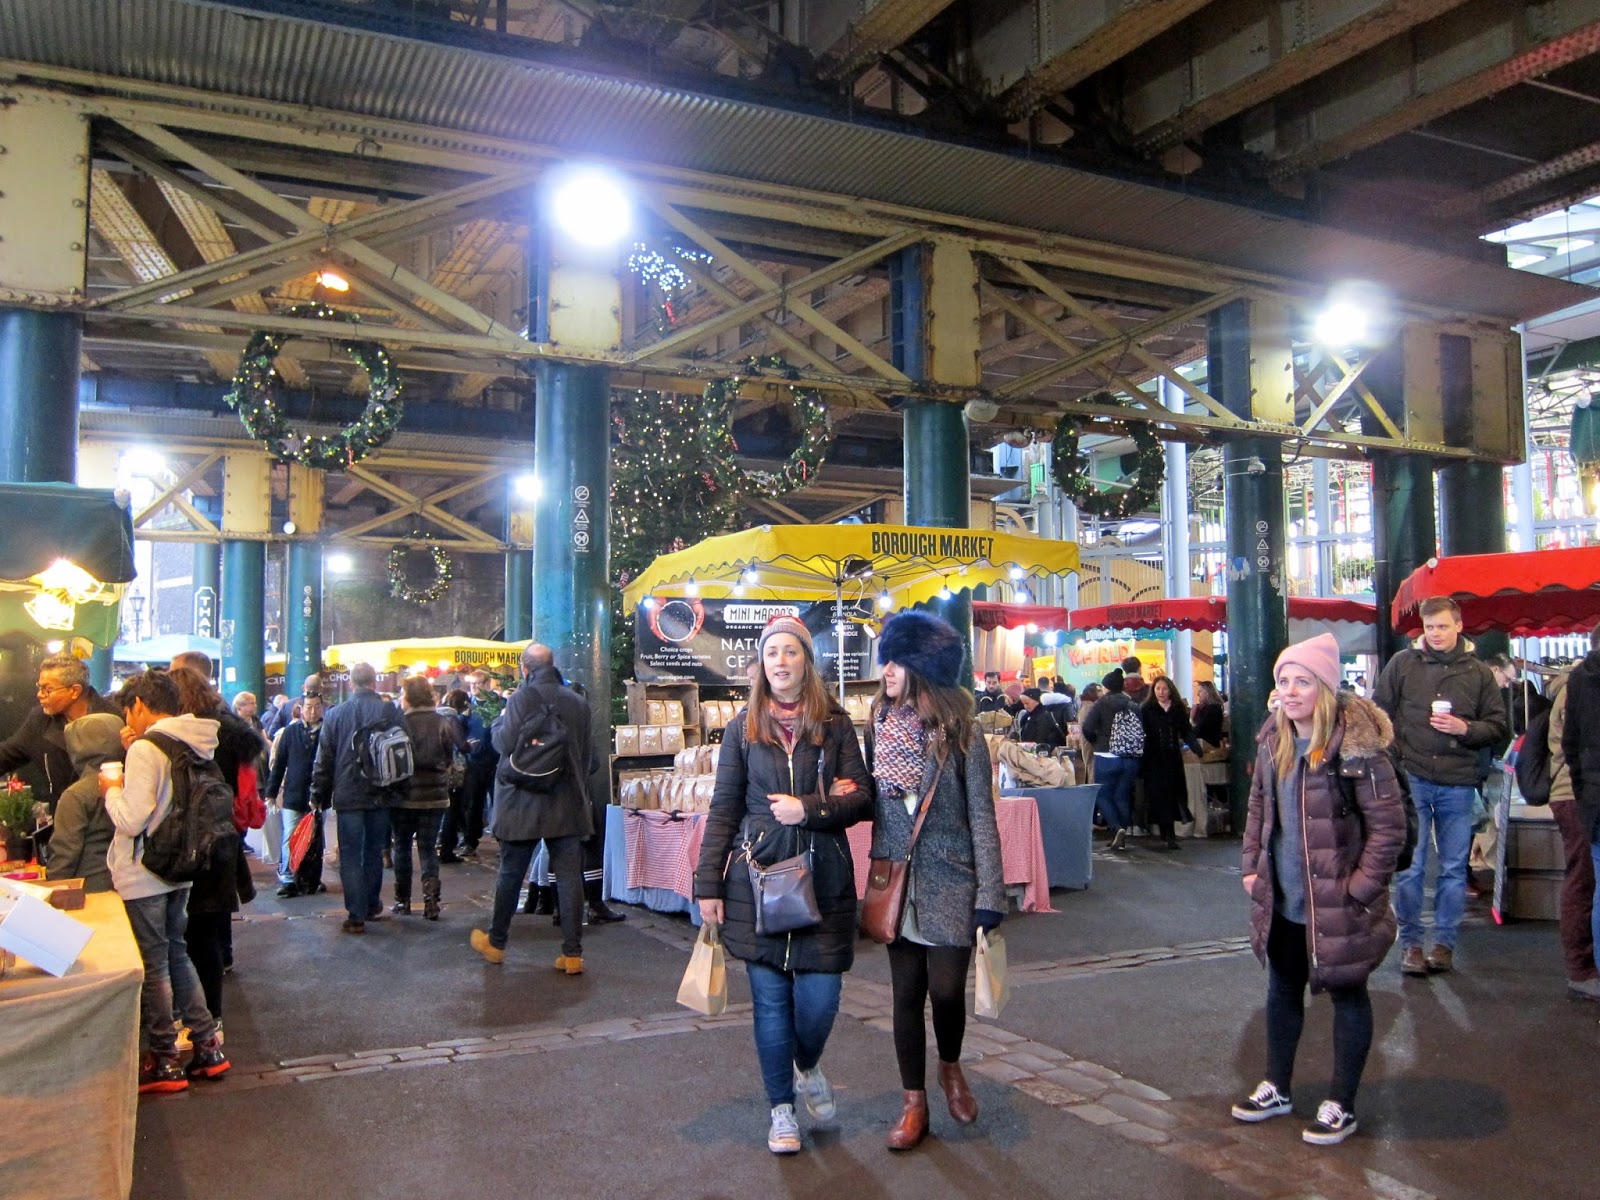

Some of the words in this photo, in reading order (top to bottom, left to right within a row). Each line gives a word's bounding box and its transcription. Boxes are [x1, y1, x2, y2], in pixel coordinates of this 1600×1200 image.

[871, 531, 937, 557] BOROUGH
[940, 534, 995, 559] MARKET
[729, 607, 750, 621] MINI
[454, 650, 495, 664] BOROUGH
[497, 652, 521, 665] MARK
